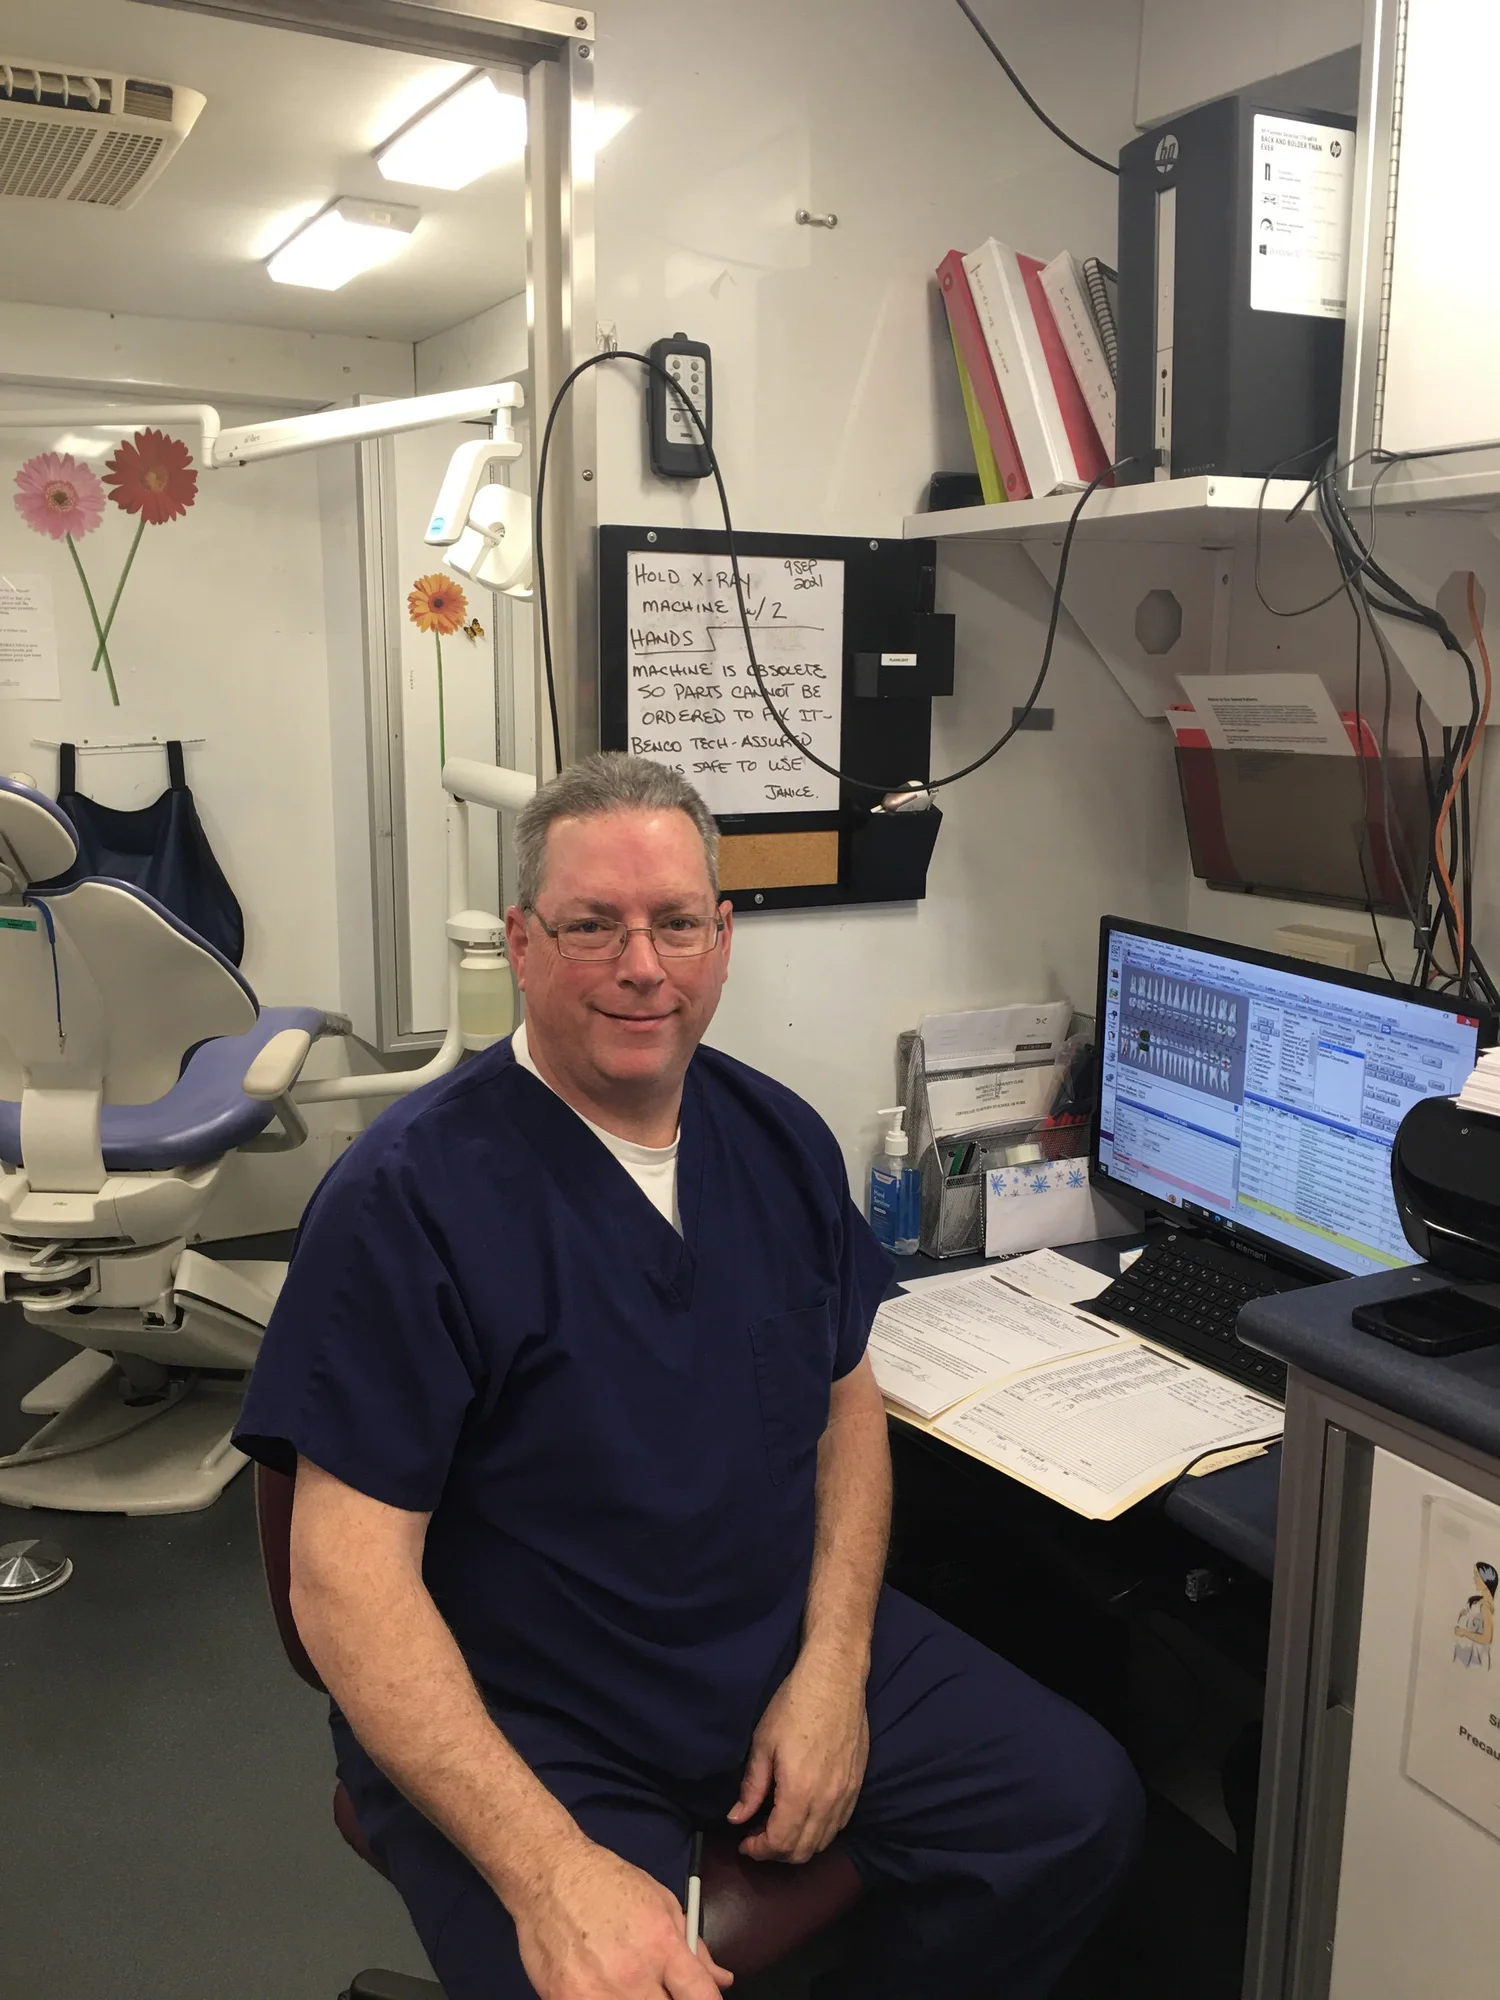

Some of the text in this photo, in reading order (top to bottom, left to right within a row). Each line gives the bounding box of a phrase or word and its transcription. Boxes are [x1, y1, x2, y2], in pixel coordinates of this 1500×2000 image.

[1276, 138, 1287, 146] AND
[1308, 143, 1323, 152] THAN
[635, 563, 680, 586] HOLD
[794, 574, 823, 590] 2021
[643, 600, 729, 613] MACHINE
[772, 602, 787, 619] 2
[630, 628, 694, 649] HANDS
[633, 662, 827, 679] MACHINE IS OBSOLETE
[638, 683, 821, 701] SO PARTS CANNOT BE
[642, 708, 726, 725] ORDERED
[733, 709, 754, 722] TO
[762, 707, 790, 721] FX
[631, 736, 682, 755] BENCO
[692, 759, 733, 773] SAFE
[736, 760, 757, 773] TO
[768, 757, 803, 772] USE
